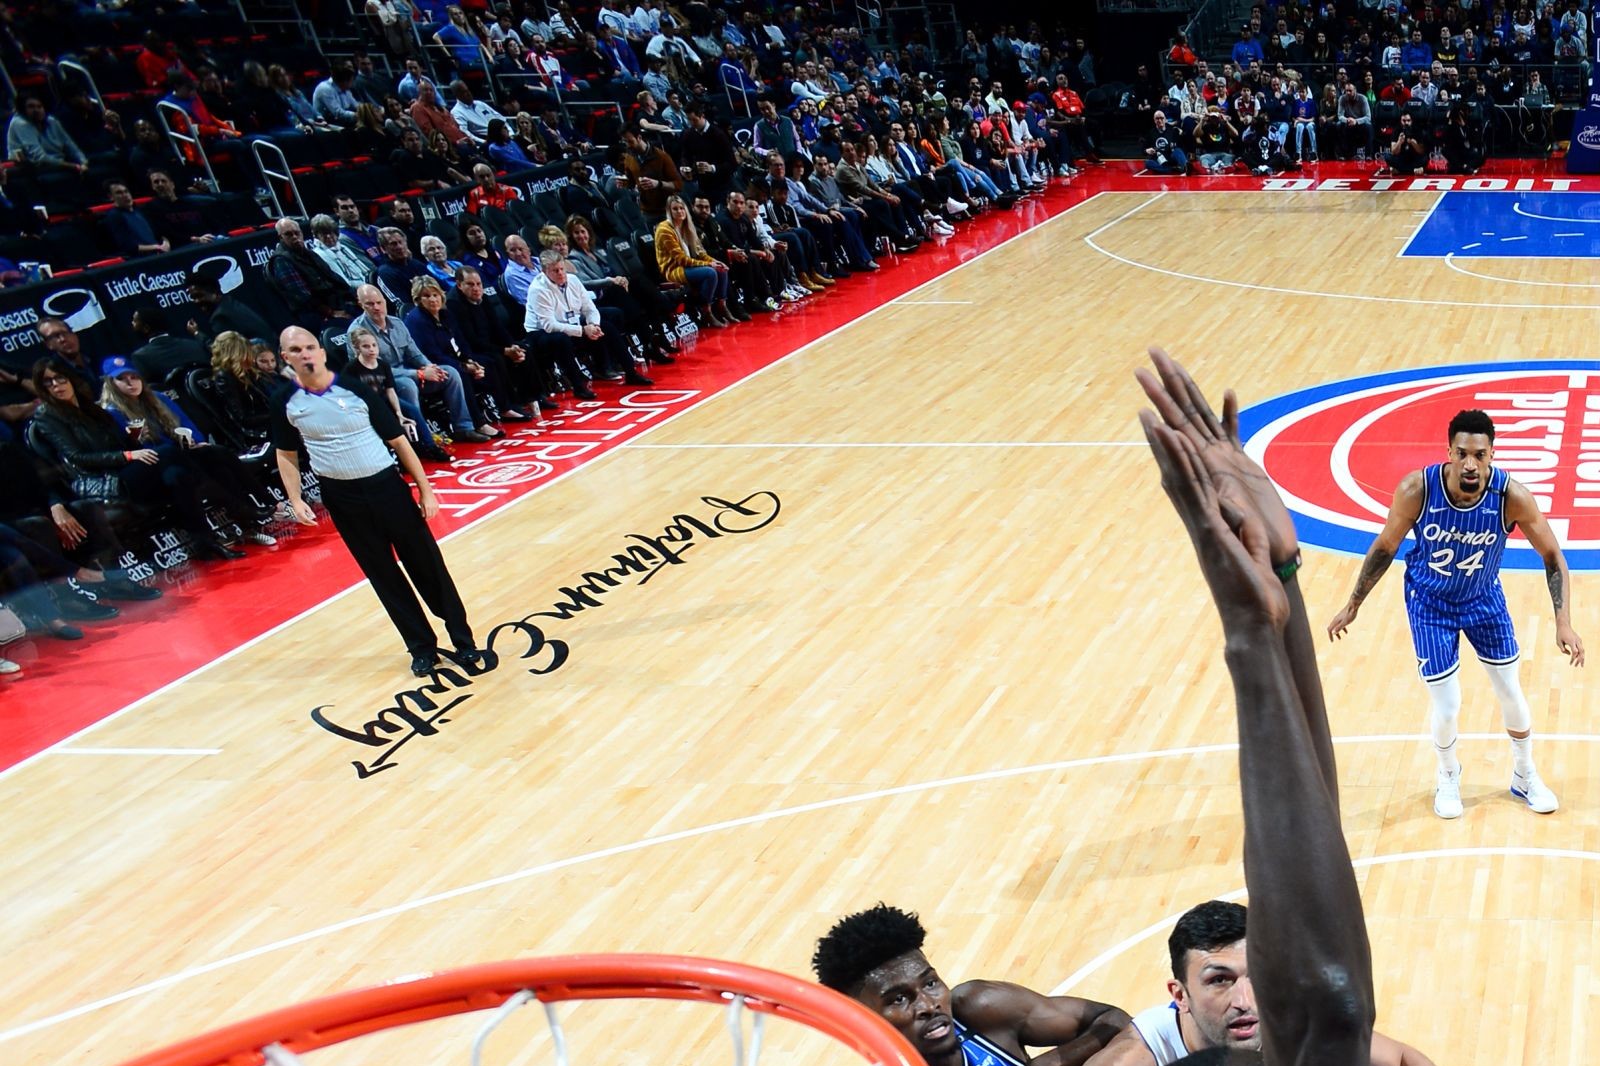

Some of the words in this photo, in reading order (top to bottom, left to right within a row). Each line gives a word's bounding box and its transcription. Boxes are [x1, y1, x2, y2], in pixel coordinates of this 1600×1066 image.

[1261, 178, 1581, 192] DETROIT
[105, 277, 142, 302] Little
[138, 270, 186, 292] Caesars
[0, 307, 39, 332] esars
[1, 329, 44, 353] aren
[1427, 547, 1486, 577] 24
